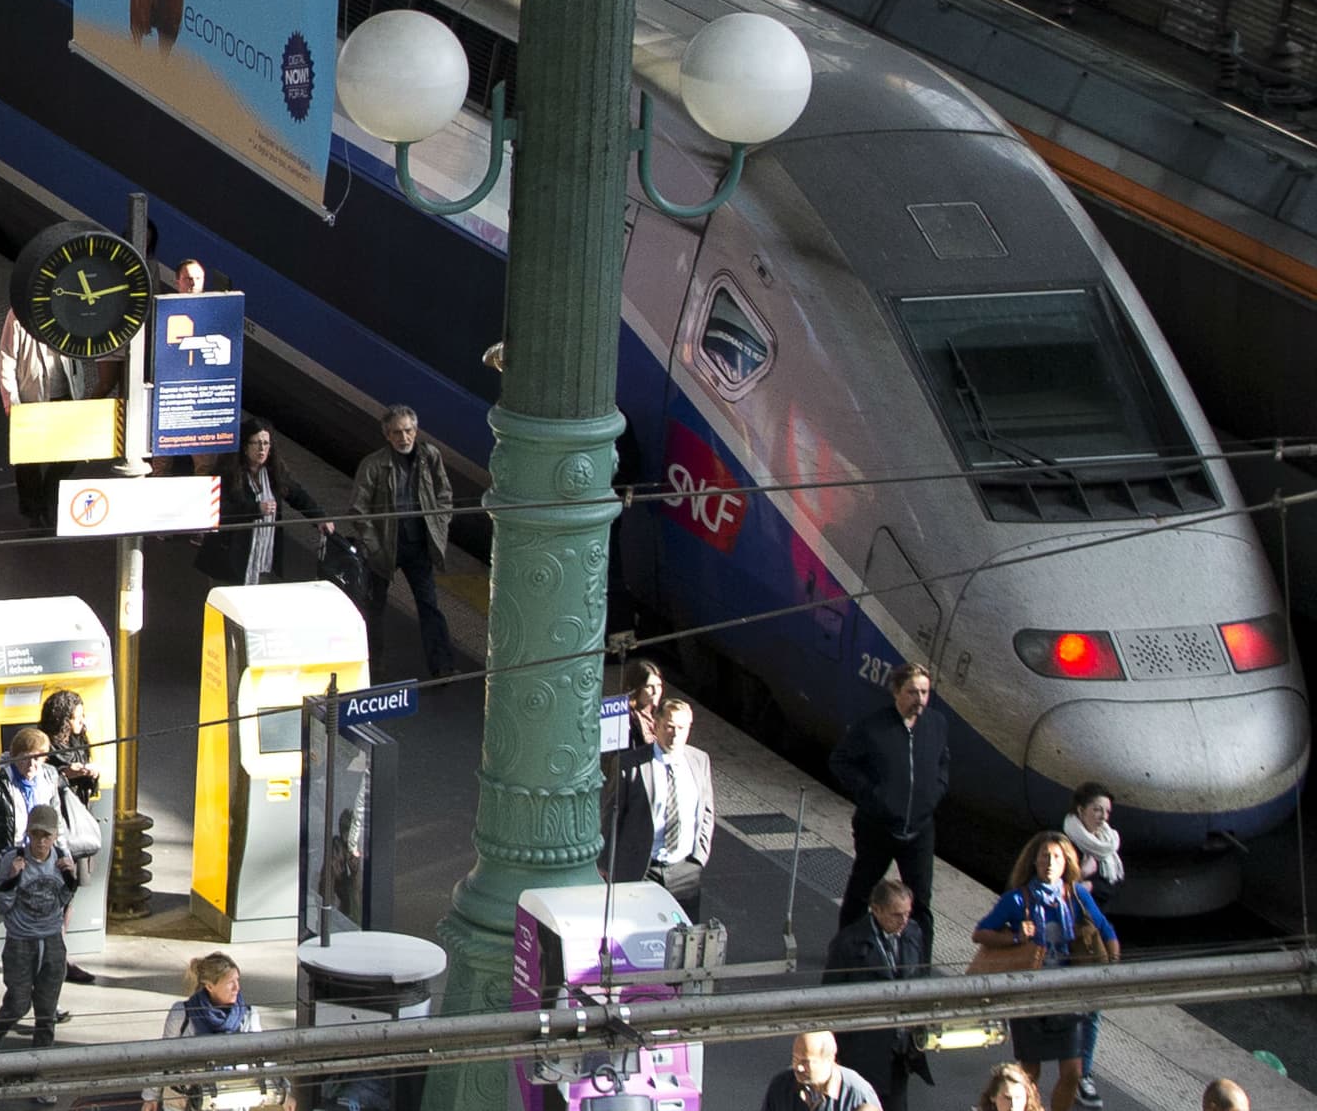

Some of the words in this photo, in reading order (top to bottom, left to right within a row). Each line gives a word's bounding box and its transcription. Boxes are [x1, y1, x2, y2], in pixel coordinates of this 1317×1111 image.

[183, 6, 274, 82] econocom
[284, 68, 309, 85] NOW!
[664, 463, 742, 533] SNCF
[858, 653, 893, 686] 287
[346, 688, 409, 717] Accueil
